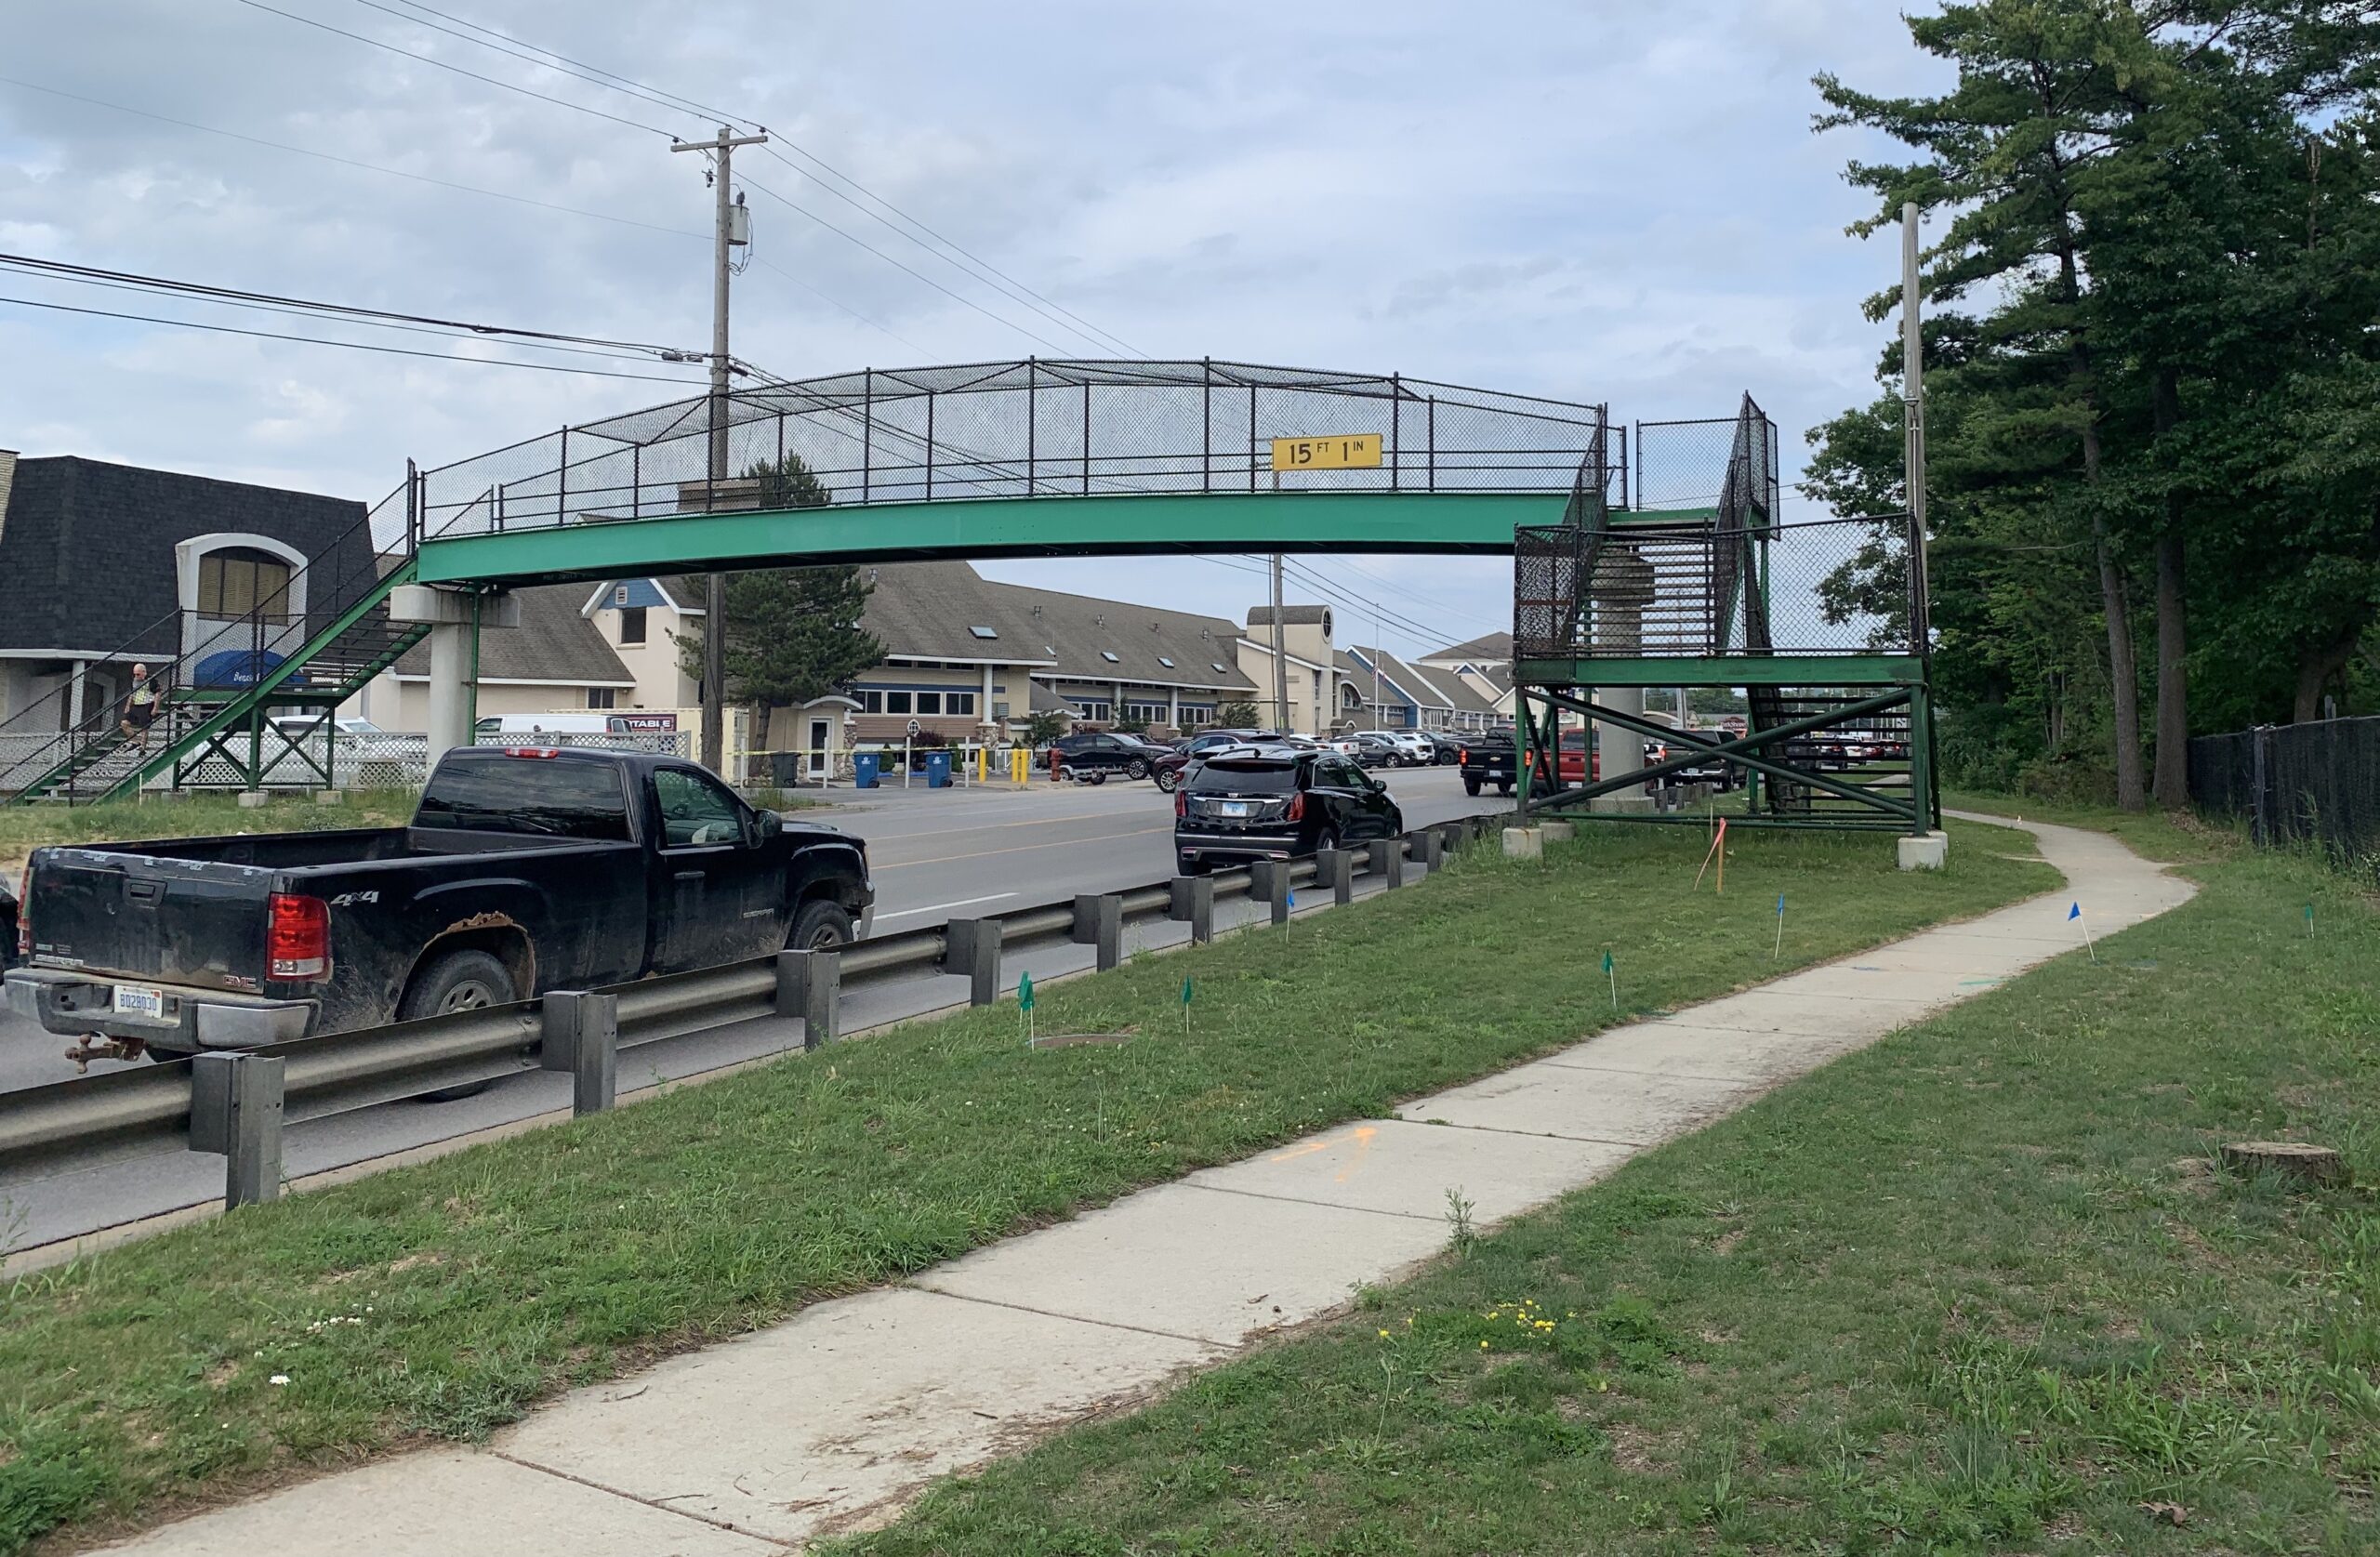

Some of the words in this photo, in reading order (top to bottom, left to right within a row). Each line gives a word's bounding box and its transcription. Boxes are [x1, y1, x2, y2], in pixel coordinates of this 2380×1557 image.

[1289, 443, 1312, 464] 15
[1316, 442, 1329, 453] FT
[1342, 442, 1348, 461] 1
[1353, 441, 1364, 452] IN
[629, 719, 671, 728] TABLE
[224, 974, 257, 989] GMC
